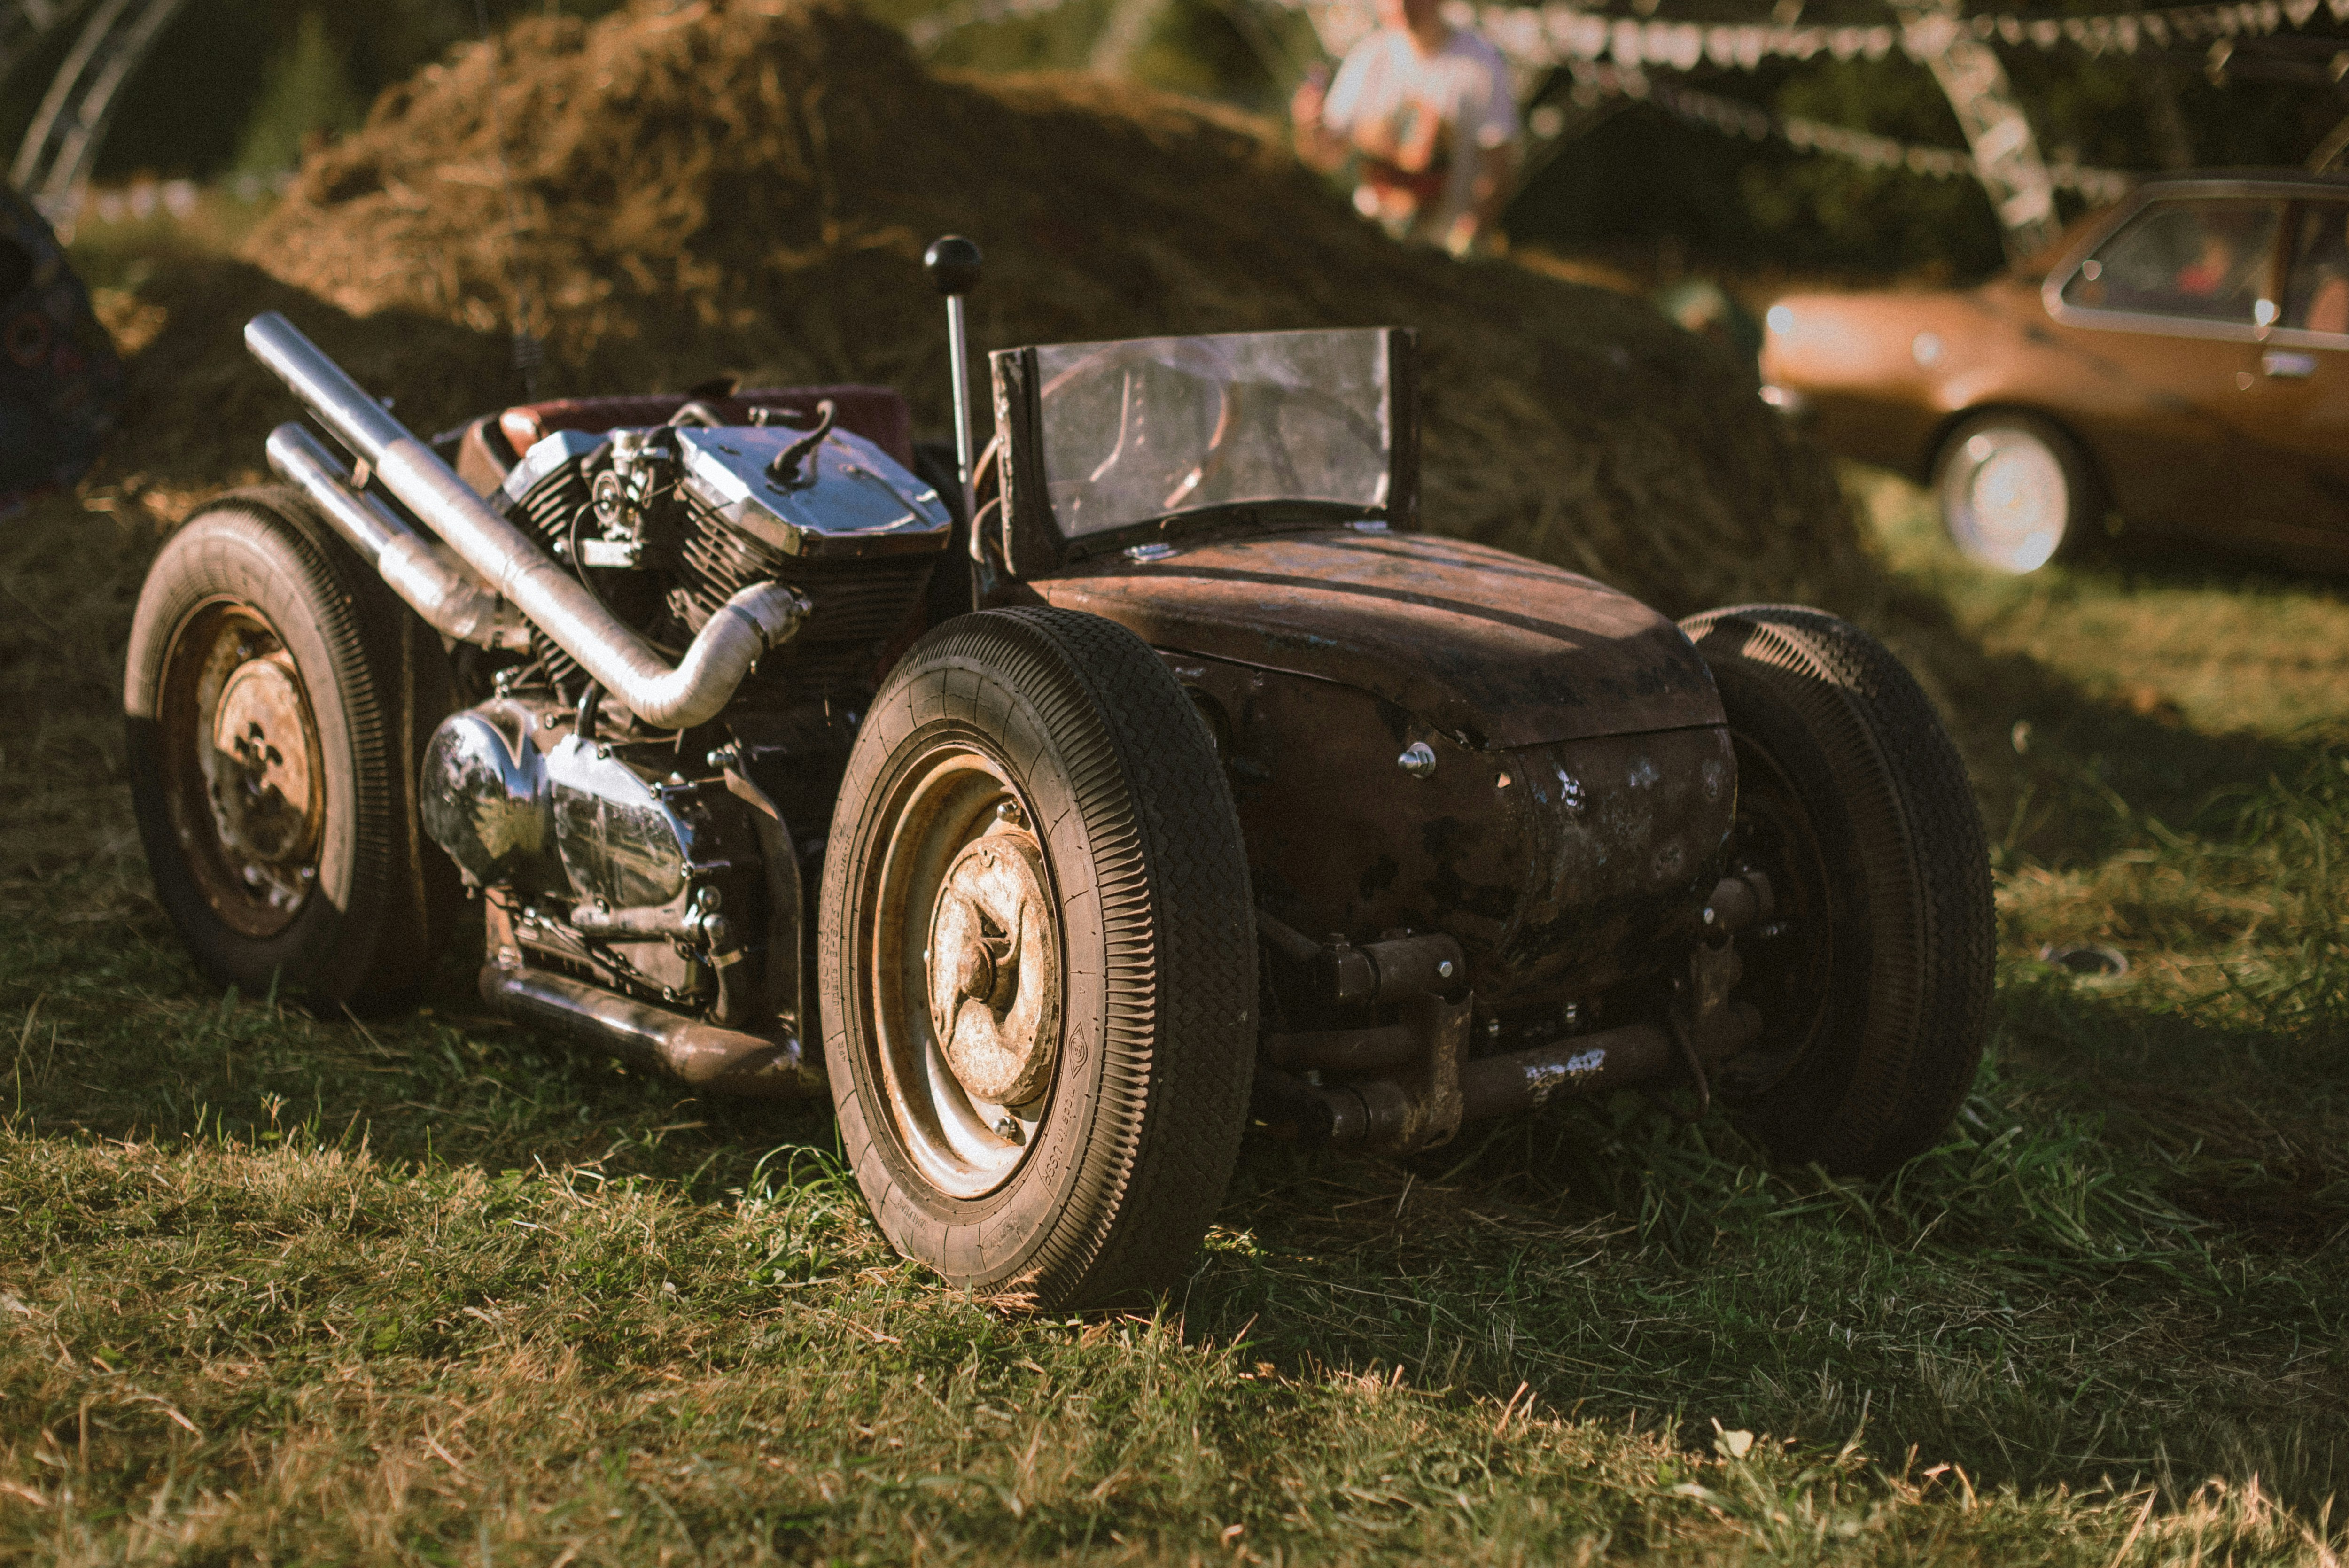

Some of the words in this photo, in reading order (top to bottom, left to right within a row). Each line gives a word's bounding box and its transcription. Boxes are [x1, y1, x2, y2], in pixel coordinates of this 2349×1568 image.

[1062, 1085, 1076, 1125] made
[1057, 1128, 1068, 1143] in
[1042, 1145, 1064, 1186] USSR
